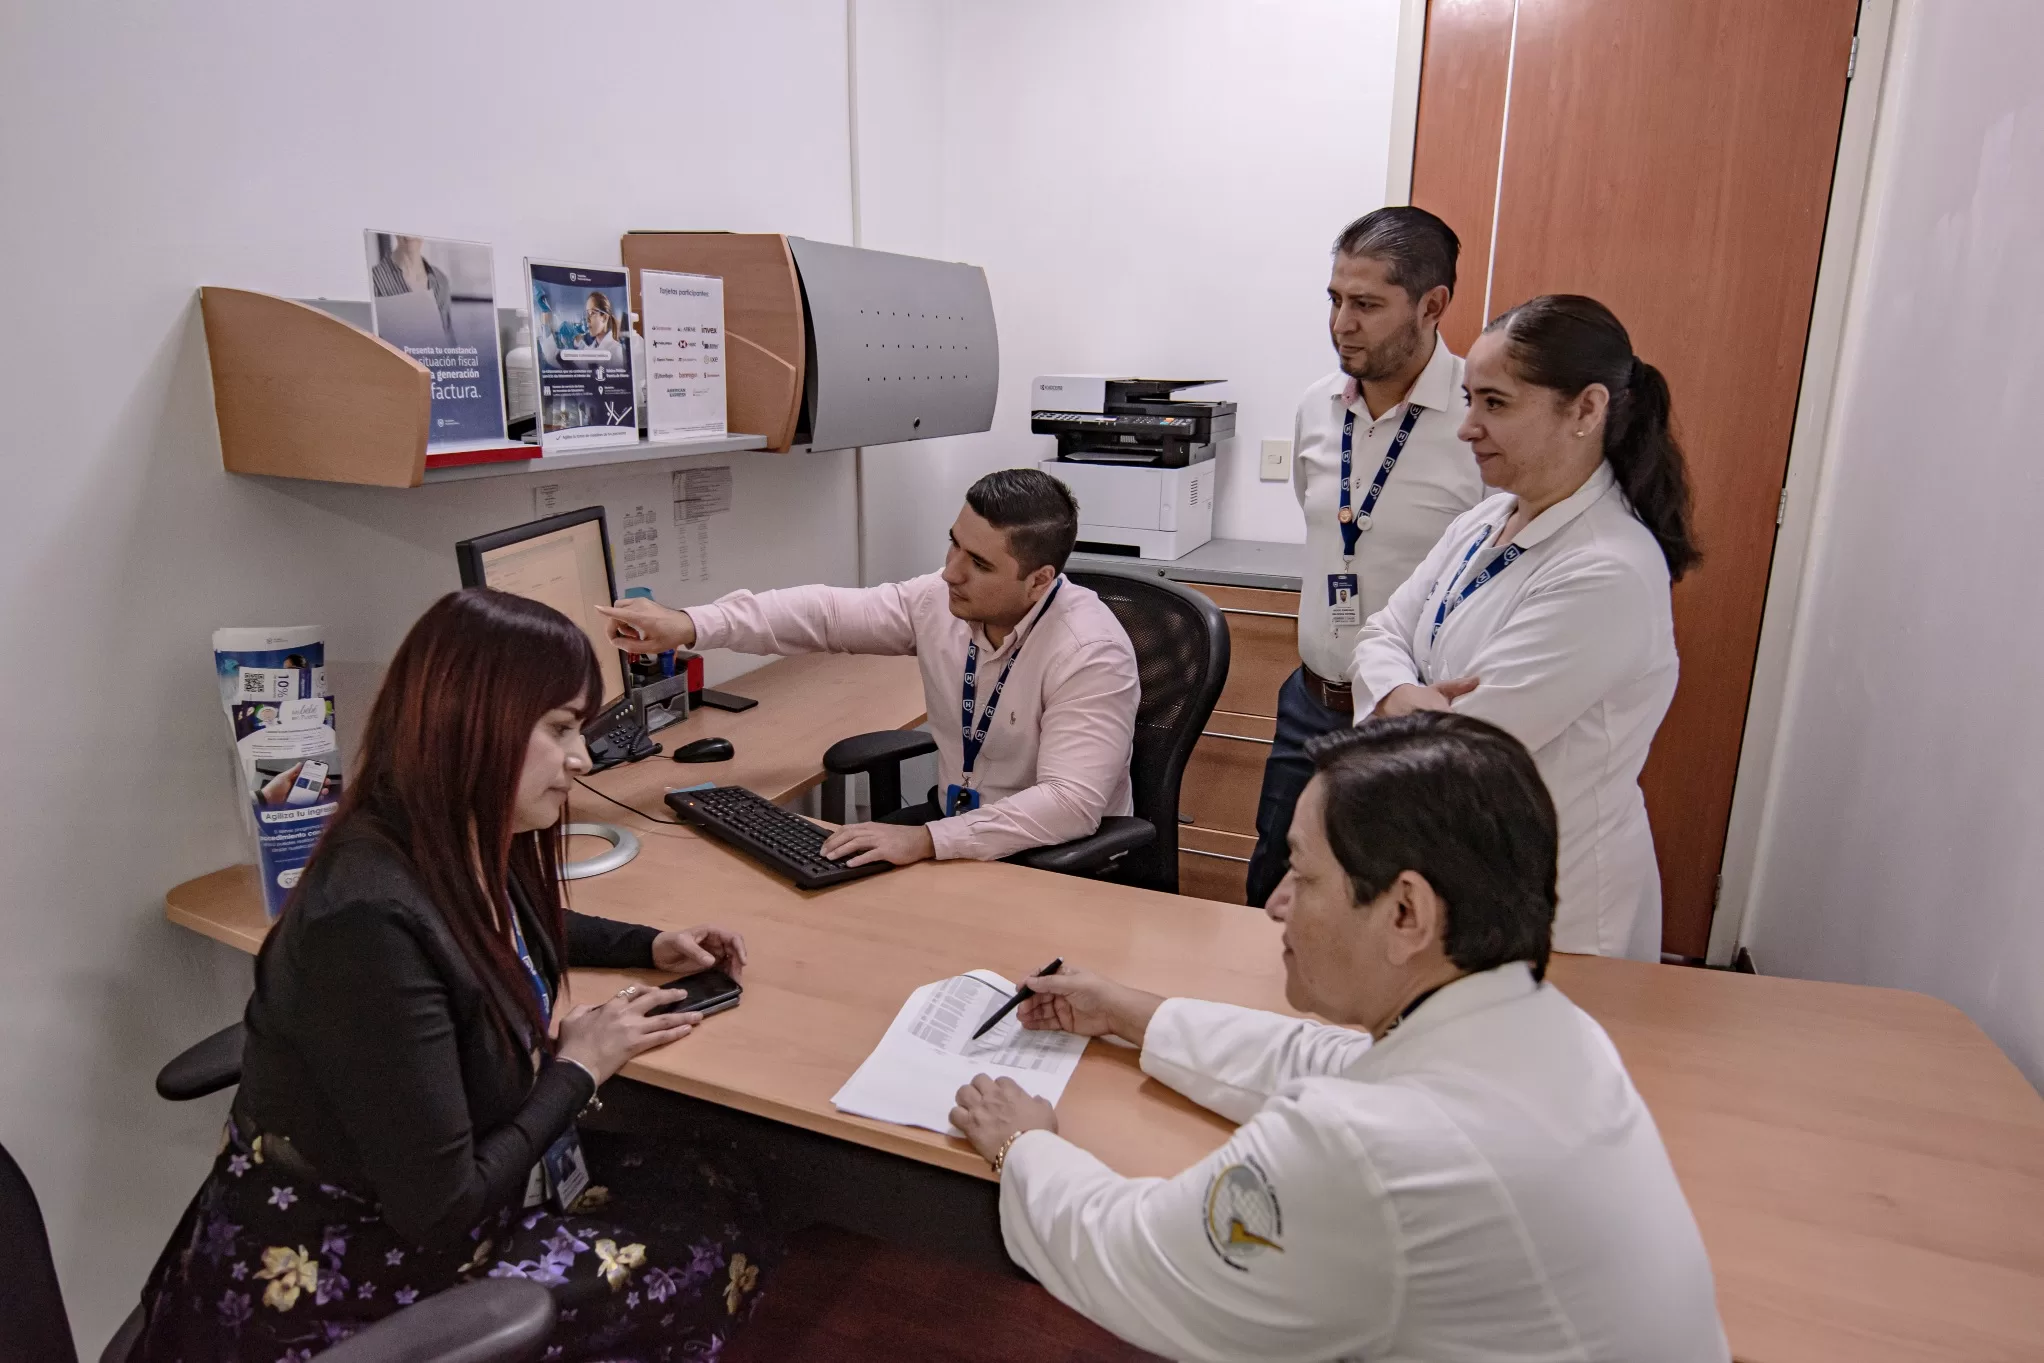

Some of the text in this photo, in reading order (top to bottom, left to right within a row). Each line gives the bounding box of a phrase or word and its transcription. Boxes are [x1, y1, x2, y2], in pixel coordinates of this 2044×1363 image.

[404, 346, 434, 354] Presenta
[444, 346, 478, 354] constancia
[458, 356, 478, 366] fiscal
[437, 368, 480, 381] generación
[431, 382, 481, 399] factura.
[278, 675, 289, 698] 10%
[266, 813, 294, 821] Agiliza
